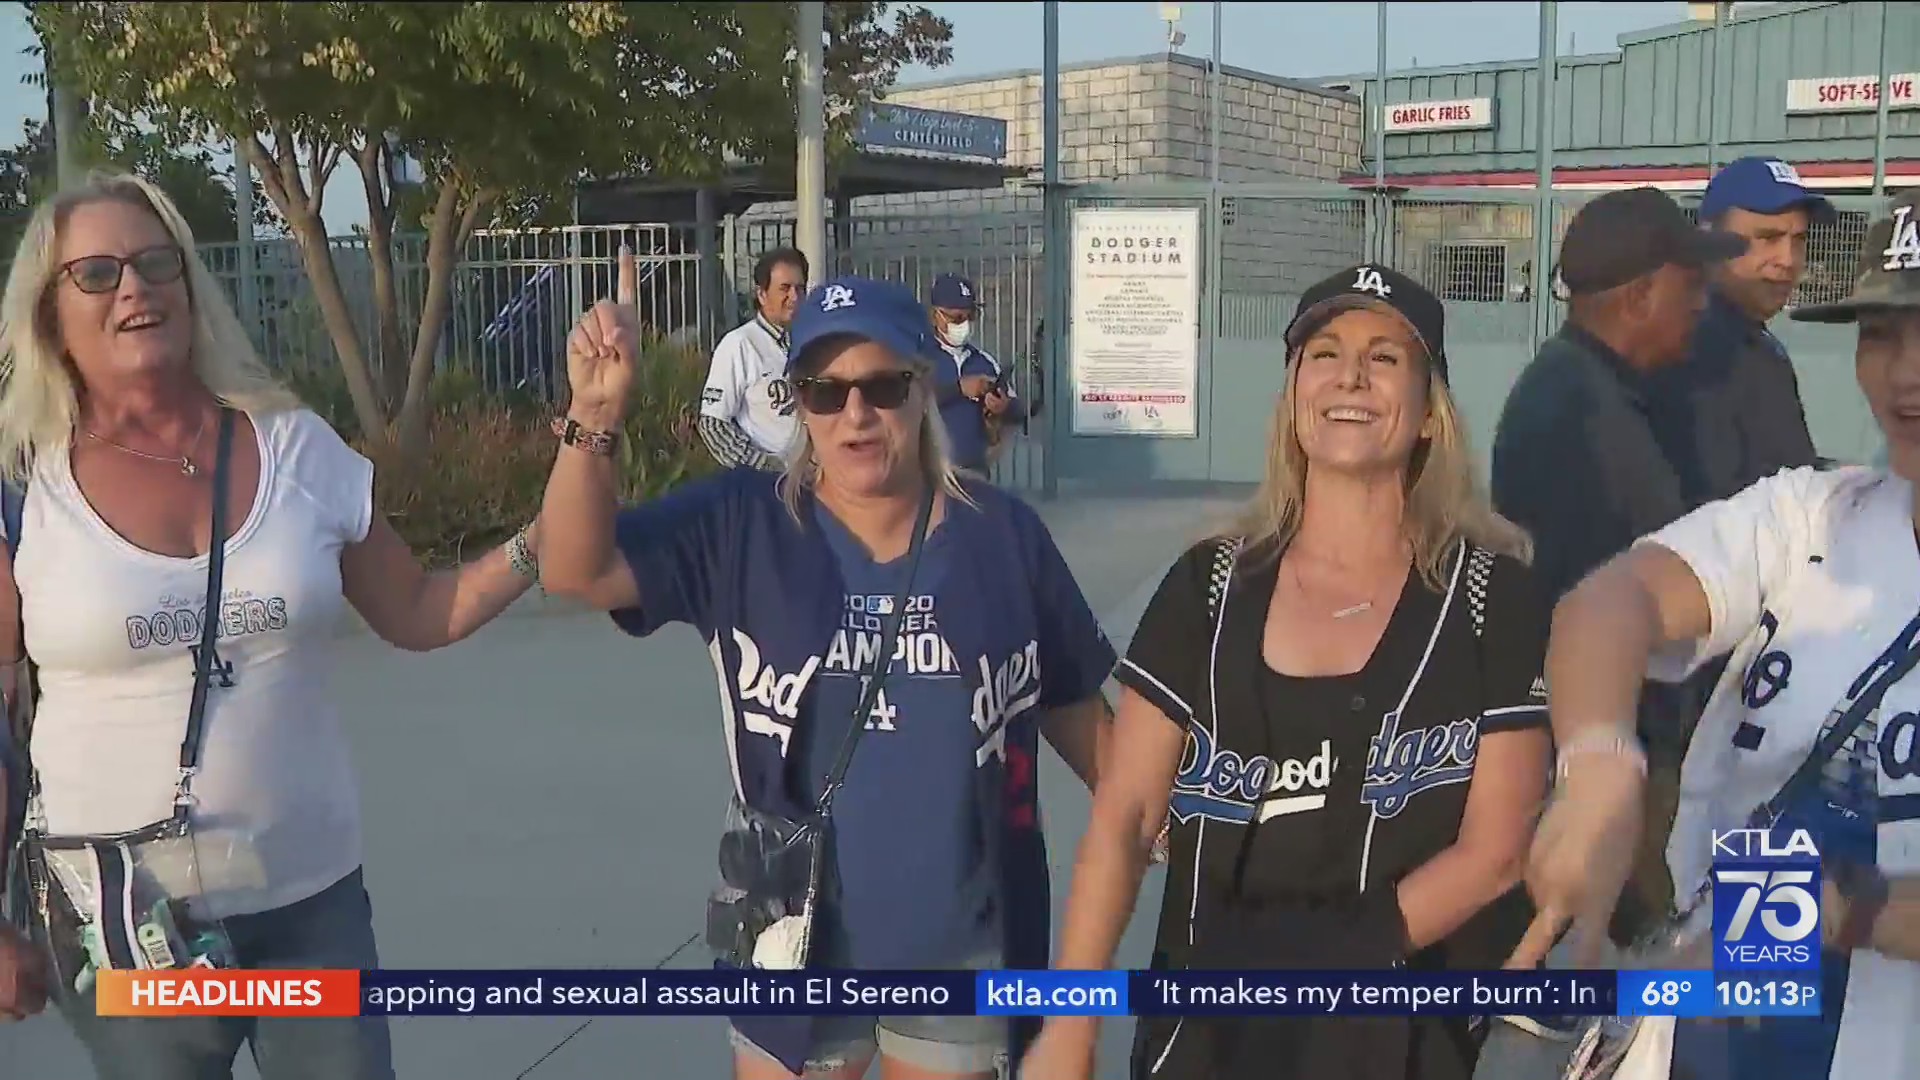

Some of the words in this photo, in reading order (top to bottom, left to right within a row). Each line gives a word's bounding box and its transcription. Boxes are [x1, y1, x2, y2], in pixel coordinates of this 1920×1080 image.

[1818, 81, 1912, 102] SOFT-SEVE
[1393, 107, 1435, 124] GARLIC
[1440, 106, 1471, 120] FRIES
[894, 129, 973, 149] CENTERFIELD
[1091, 237, 1177, 248] DODGER
[1087, 252, 1181, 264] STADIUM
[1352, 267, 1392, 298] LA
[820, 284, 856, 312] LA
[905, 595, 935, 612] 20
